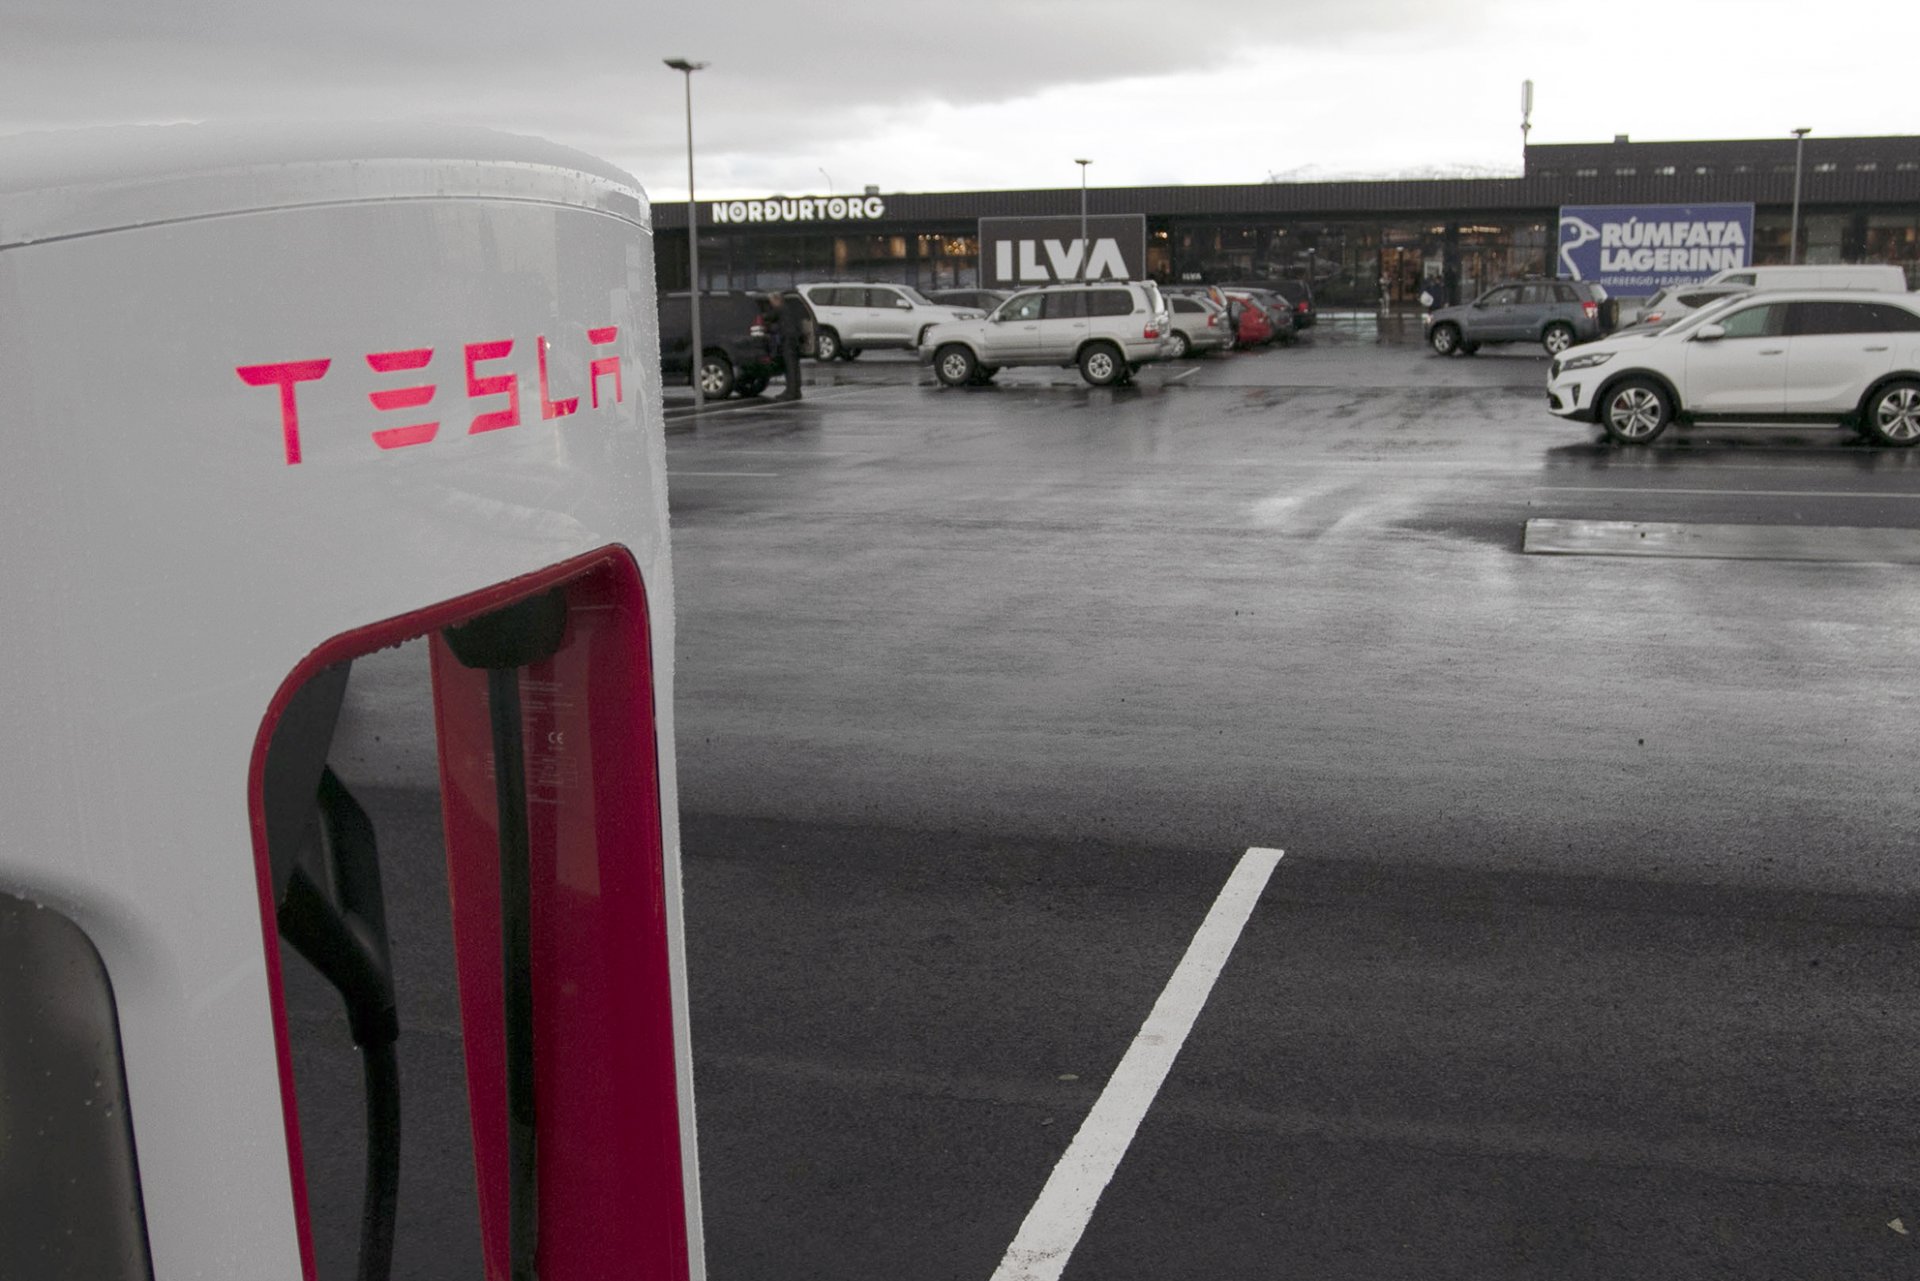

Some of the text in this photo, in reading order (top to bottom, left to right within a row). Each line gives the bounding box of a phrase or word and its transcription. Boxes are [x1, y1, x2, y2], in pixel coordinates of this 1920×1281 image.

[712, 197, 885, 223] NORÐURTORG
[1601, 216, 1746, 247] RÚMFATA
[995, 238, 1130, 281] ILVA
[1601, 248, 1745, 272] LAGERINN
[236, 326, 623, 464] TESLA
